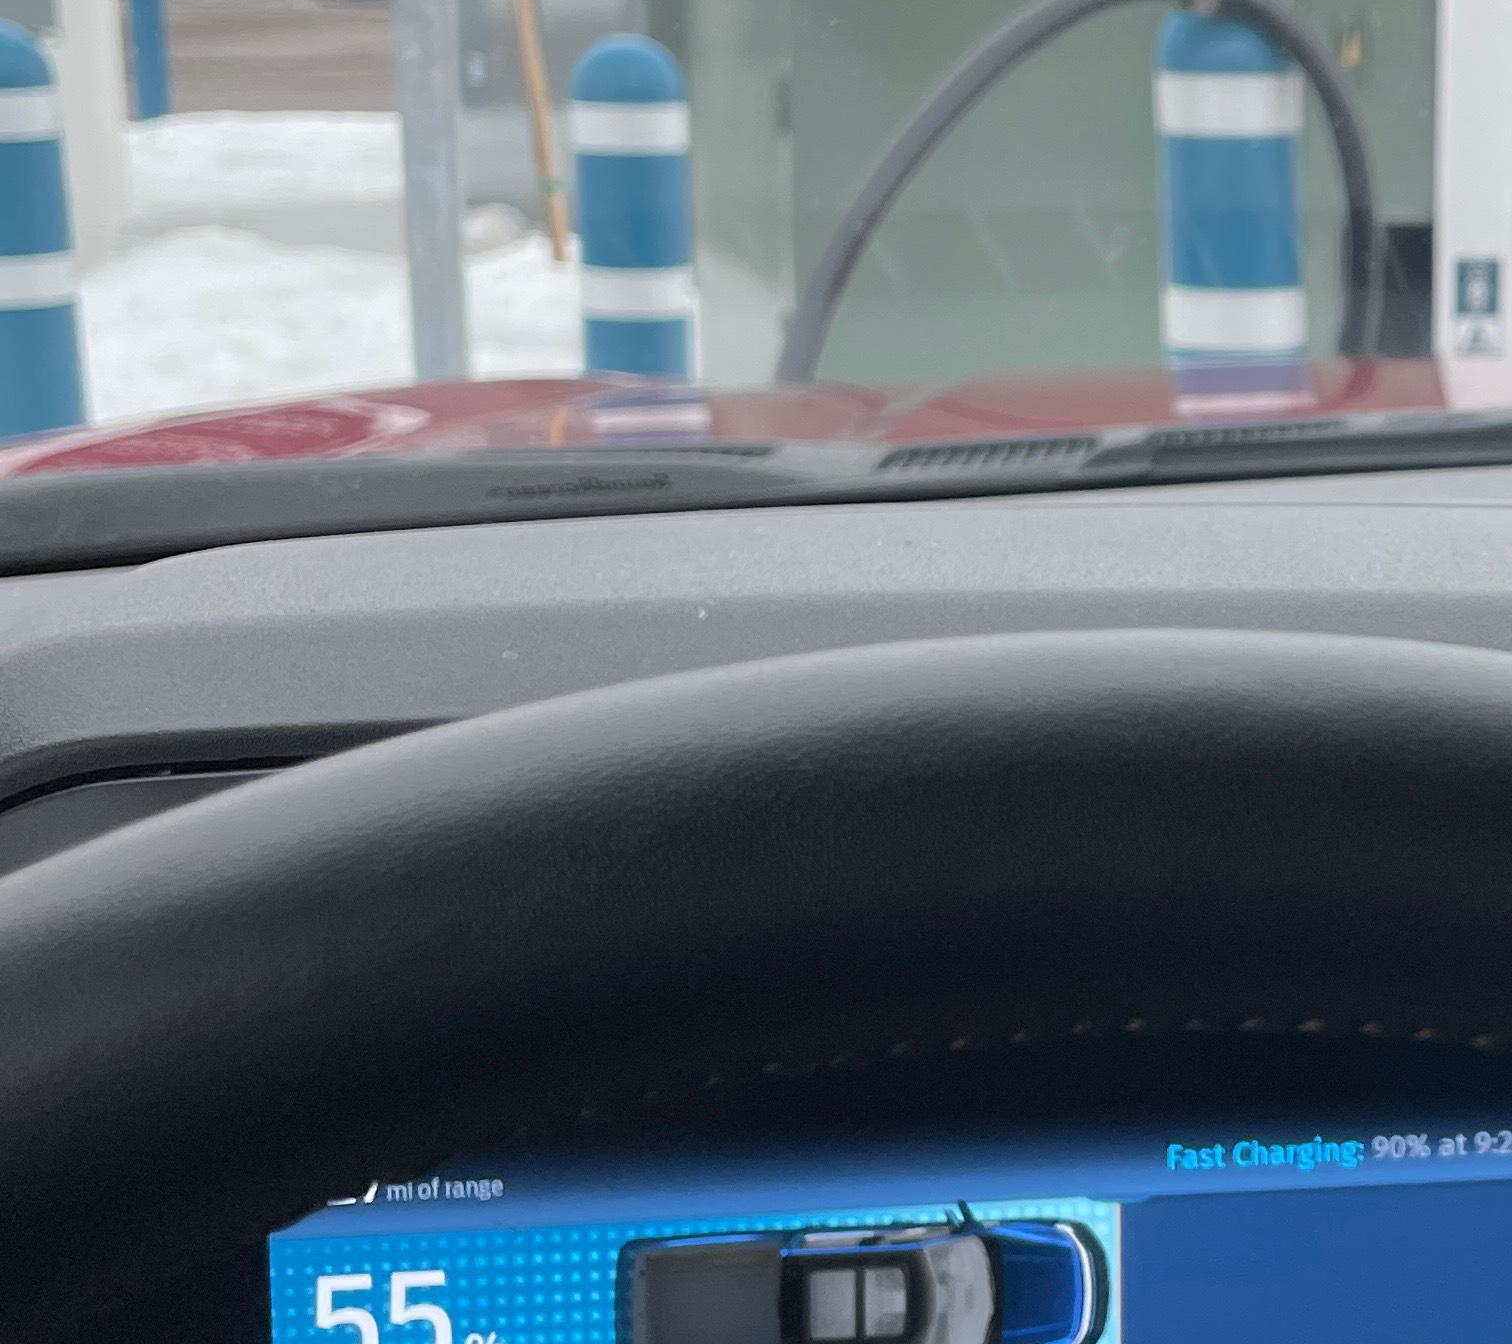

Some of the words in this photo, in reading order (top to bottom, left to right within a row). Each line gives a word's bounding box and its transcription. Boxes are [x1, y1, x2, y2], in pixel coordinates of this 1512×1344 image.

[1166, 1143, 1226, 1170] Fast
[1232, 1136, 1364, 1170] Charging:
[1371, 1133, 1431, 1159] 90%
[1438, 1134, 1467, 1156] at
[386, 1181, 413, 1202] mi
[418, 1176, 440, 1201] of
[445, 1178, 504, 1201] range
